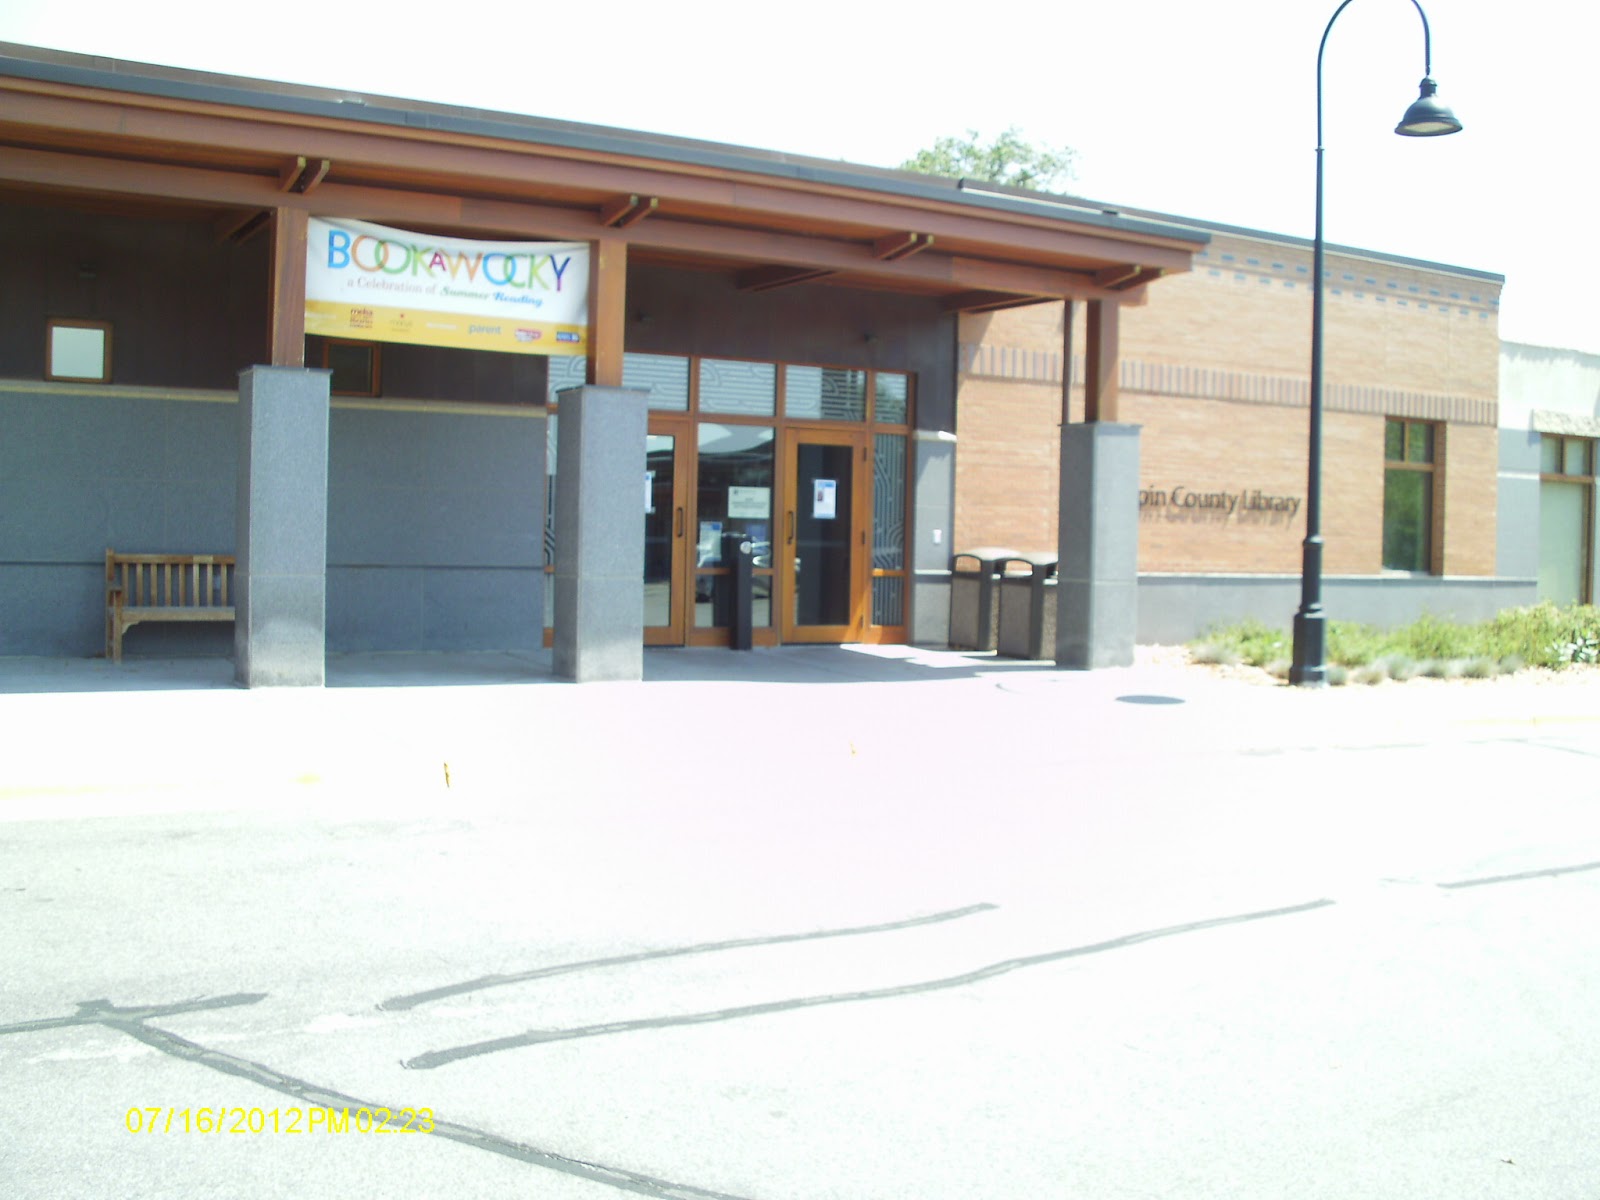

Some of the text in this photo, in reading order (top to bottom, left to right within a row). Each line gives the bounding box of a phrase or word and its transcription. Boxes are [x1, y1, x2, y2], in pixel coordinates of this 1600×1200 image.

[327, 230, 571, 292] BOOKAWOCKY
[347, 278, 543, 307] a Celebration of Summer Reading
[469, 325, 501, 335] parent
[1171, 486, 1238, 515] County
[1242, 489, 1301, 518] Library
